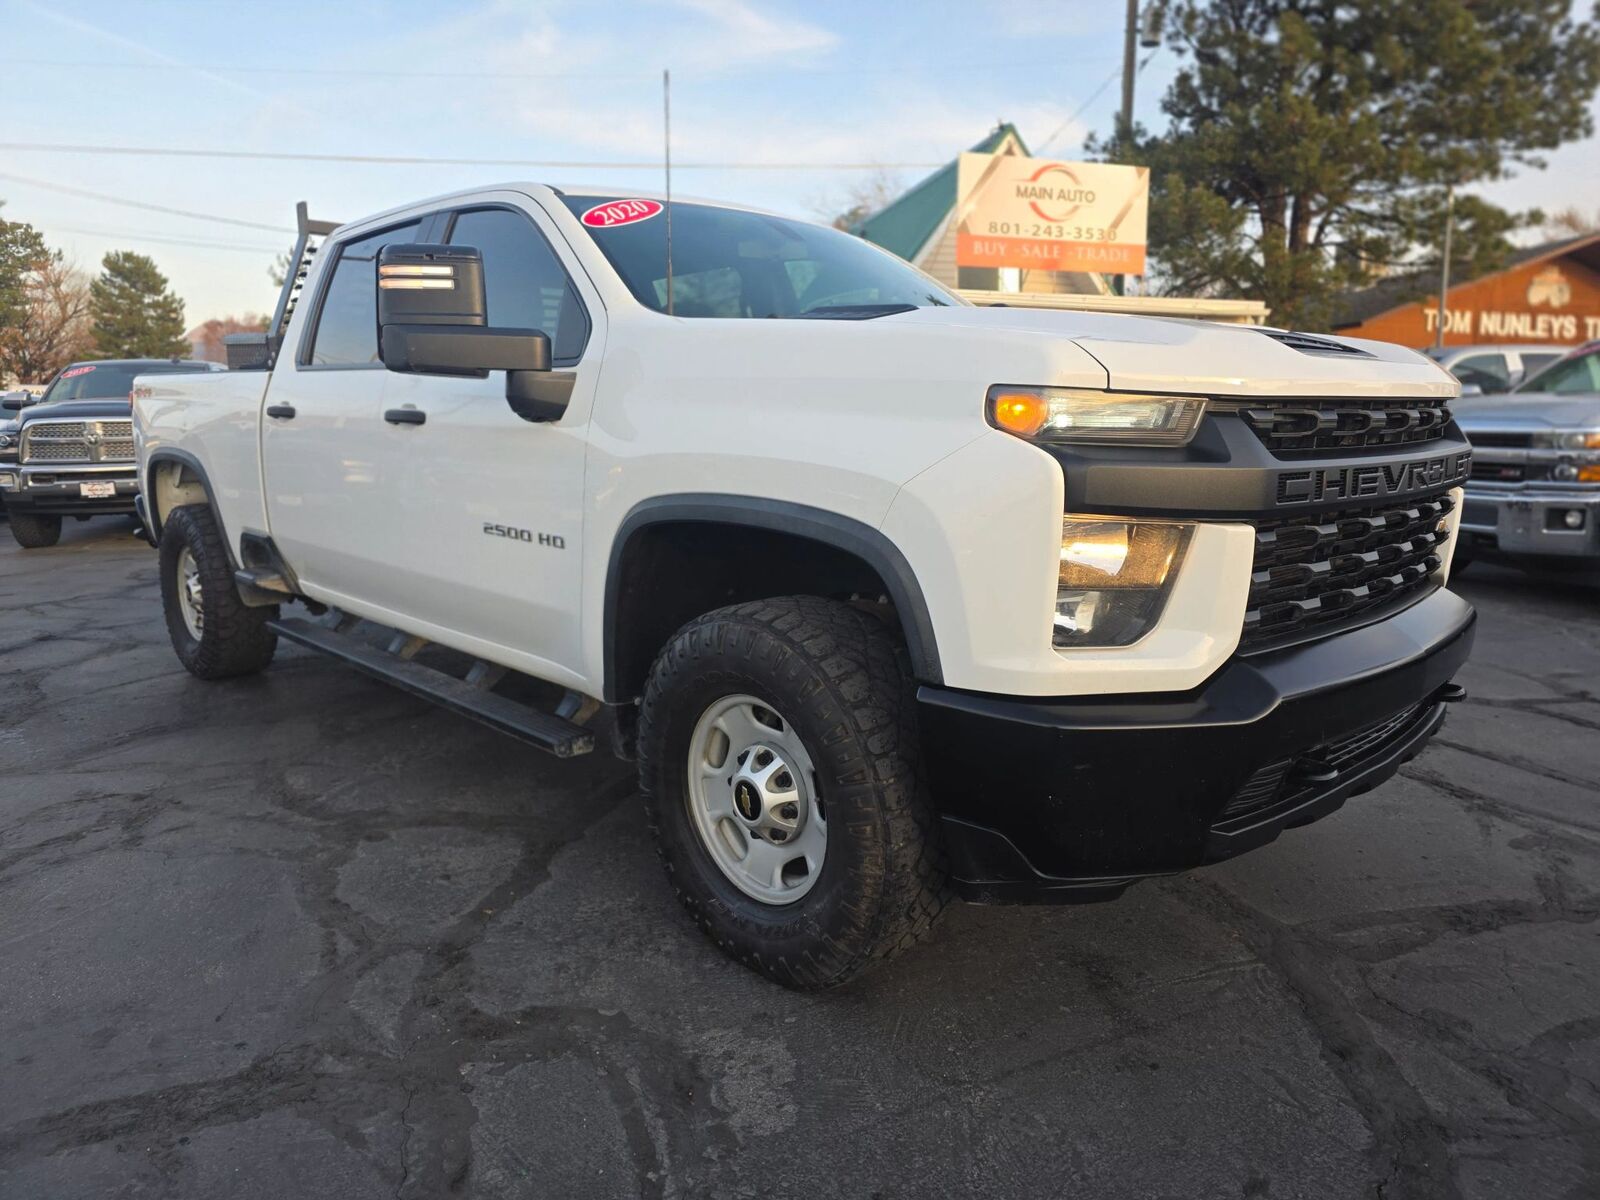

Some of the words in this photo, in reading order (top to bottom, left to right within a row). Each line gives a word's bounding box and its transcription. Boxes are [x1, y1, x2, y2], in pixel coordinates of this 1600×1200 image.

[1016, 185, 1053, 200] MAIN
[1057, 188, 1096, 204] AUTO
[594, 200, 649, 225] 2020
[988, 221, 1118, 242] 801-243-3530
[973, 240, 1008, 257] BUY
[1021, 243, 1061, 259] SALE
[1075, 246, 1130, 262] TRADE
[1423, 308, 1473, 335] TOM
[1479, 310, 1577, 339] NUNLEYS
[1276, 452, 1473, 505] CHEVROLET
[483, 522, 532, 542] 2500
[538, 532, 565, 549] HD
